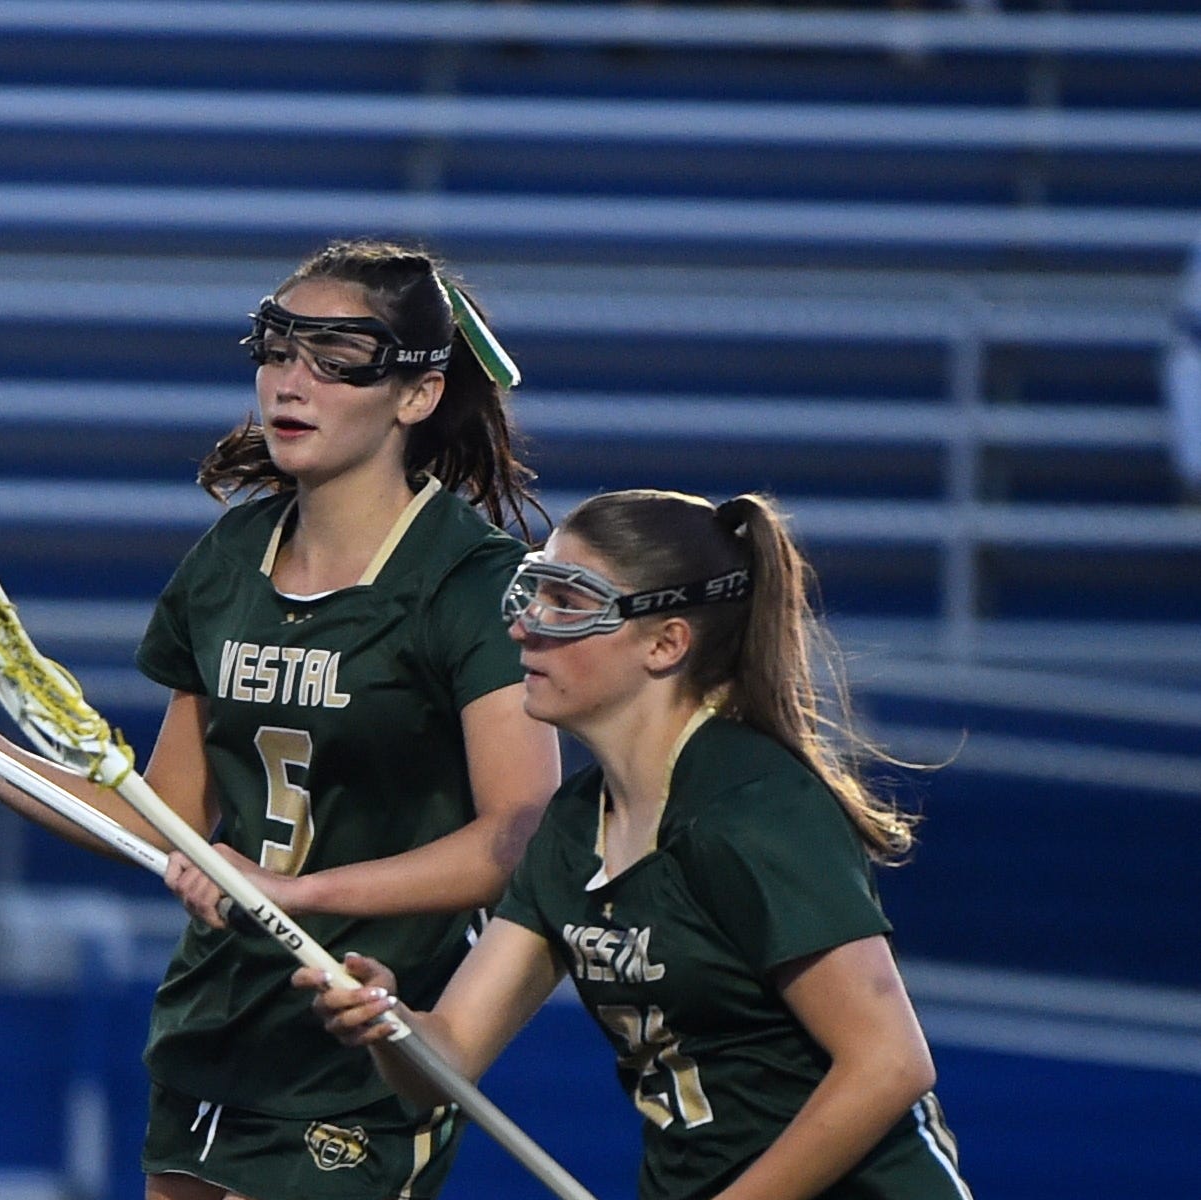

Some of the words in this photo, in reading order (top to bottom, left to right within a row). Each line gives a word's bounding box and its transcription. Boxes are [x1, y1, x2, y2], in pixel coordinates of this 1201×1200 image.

[632, 586, 687, 613] STX
[217, 639, 351, 709] VESTAL
[253, 725, 315, 878] 5
[250, 904, 304, 951] GAIT
